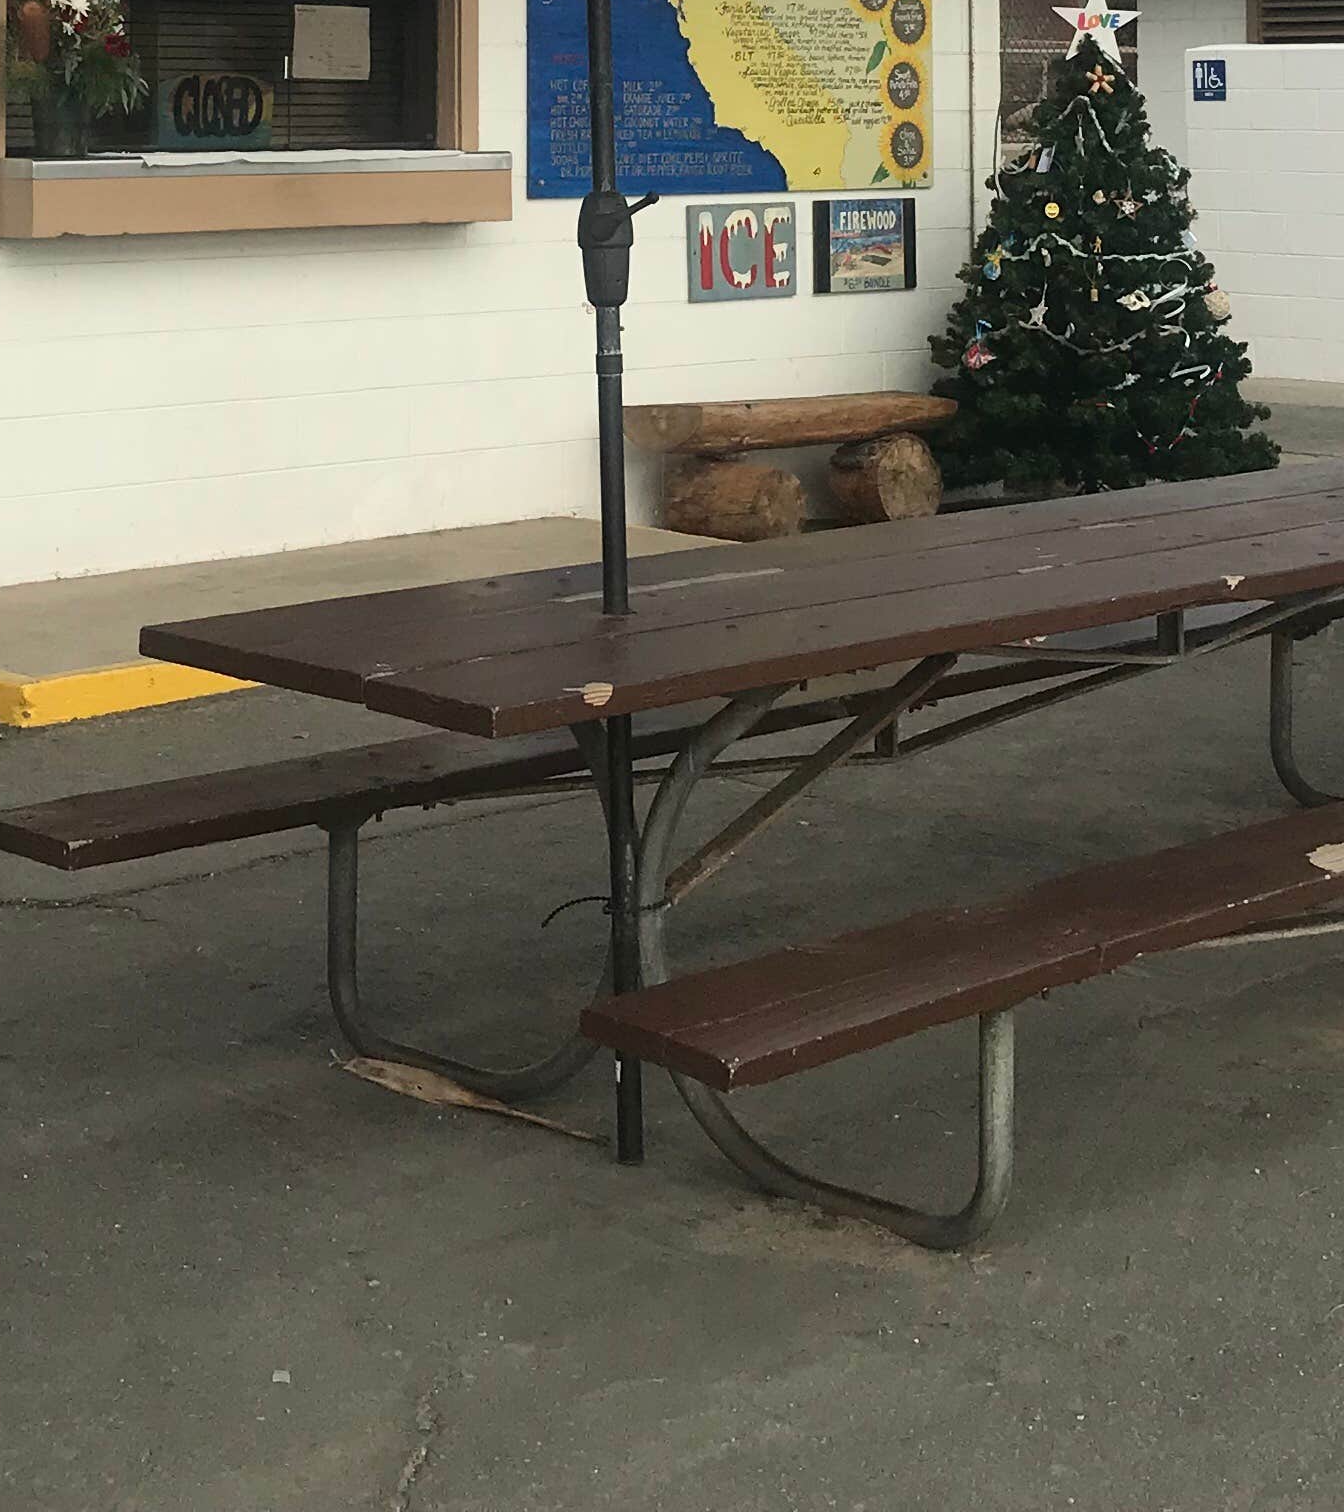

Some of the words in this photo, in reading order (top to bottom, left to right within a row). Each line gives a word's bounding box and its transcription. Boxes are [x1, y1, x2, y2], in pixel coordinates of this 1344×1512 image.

[734, 50, 755, 62] BLT
[623, 80, 643, 92] MILK
[839, 209, 897, 231] FIREWOOD
[699, 206, 791, 290] ICE
[864, 276, 891, 289] BUNDLE
